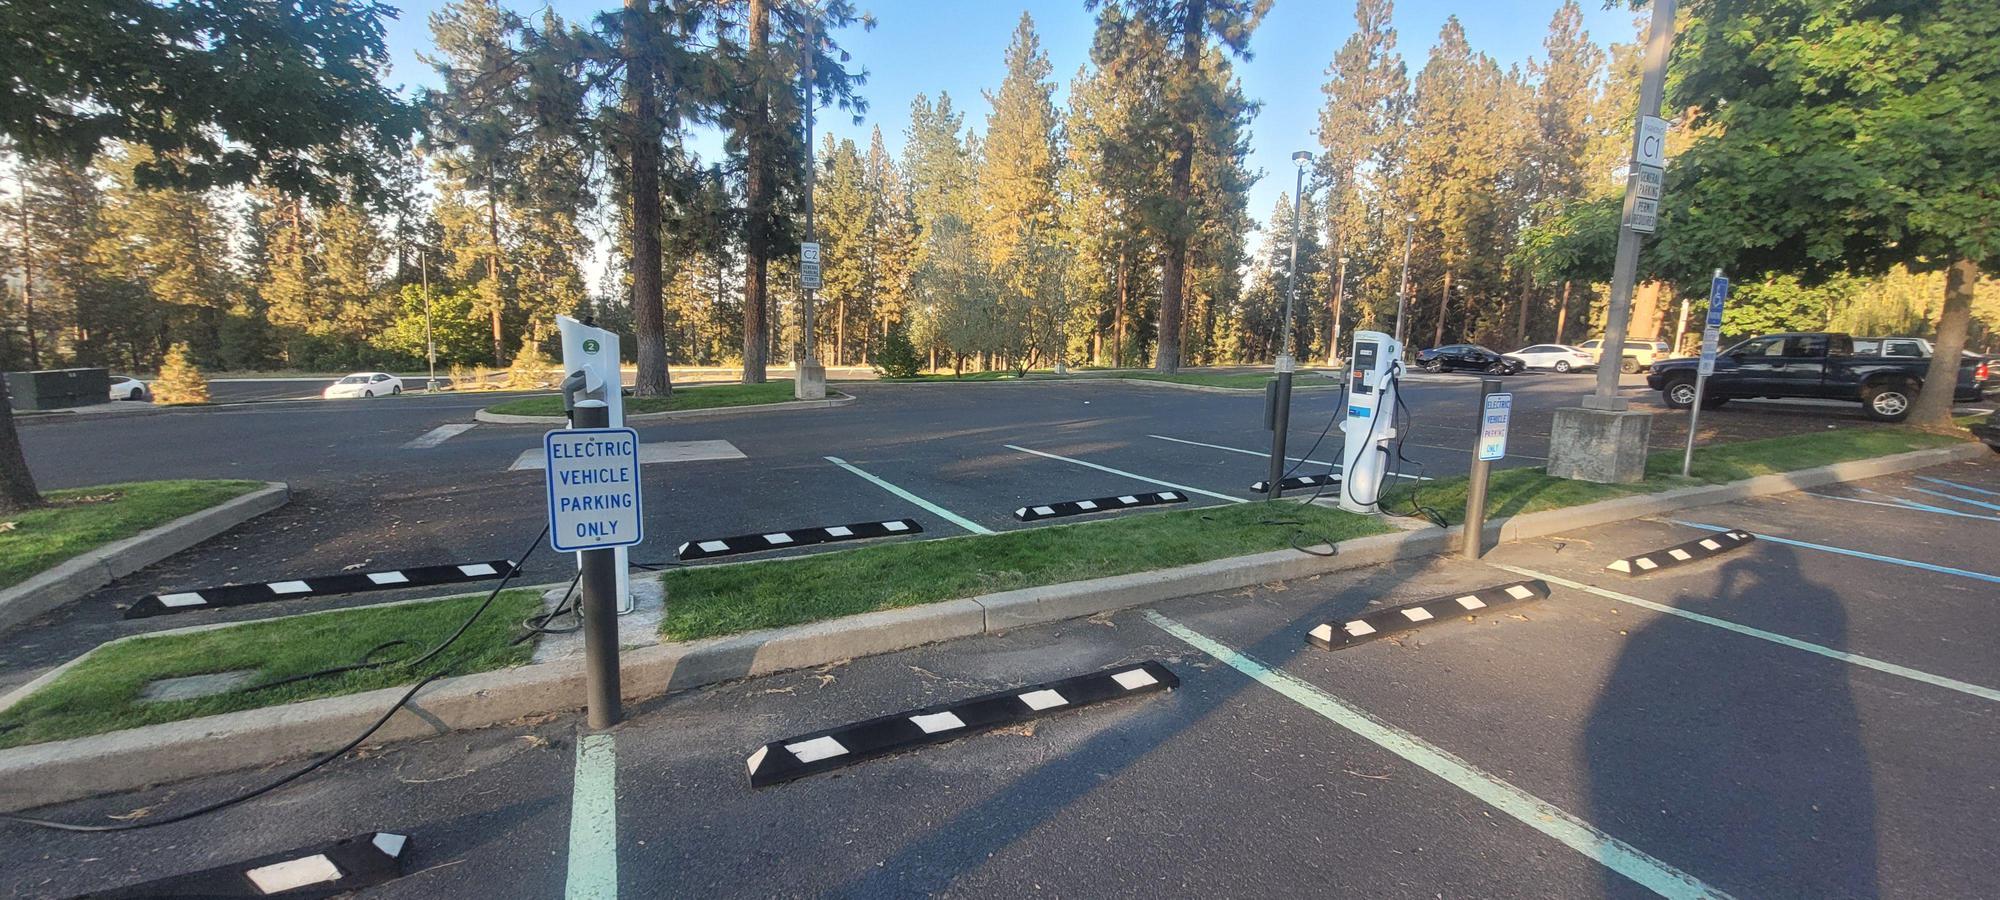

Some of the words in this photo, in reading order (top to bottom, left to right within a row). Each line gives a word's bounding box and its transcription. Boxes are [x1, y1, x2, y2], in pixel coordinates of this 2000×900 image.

[1644, 135, 1660, 159] C1
[1640, 171, 1660, 184] GENERAL
[1639, 183, 1659, 198] PARKING
[1637, 201, 1655, 213] PERMIT
[804, 250, 817, 259] C2
[588, 342, 595, 350] 2
[1486, 401, 1511, 409] ELECTRIC
[1487, 415, 1507, 423] VEHICLE
[1484, 429, 1505, 438] PARKING
[553, 441, 632, 459] ELECTRIC
[560, 468, 629, 485] VEHICLE
[561, 493, 632, 512] PARKING
[576, 520, 618, 538] ONLY
